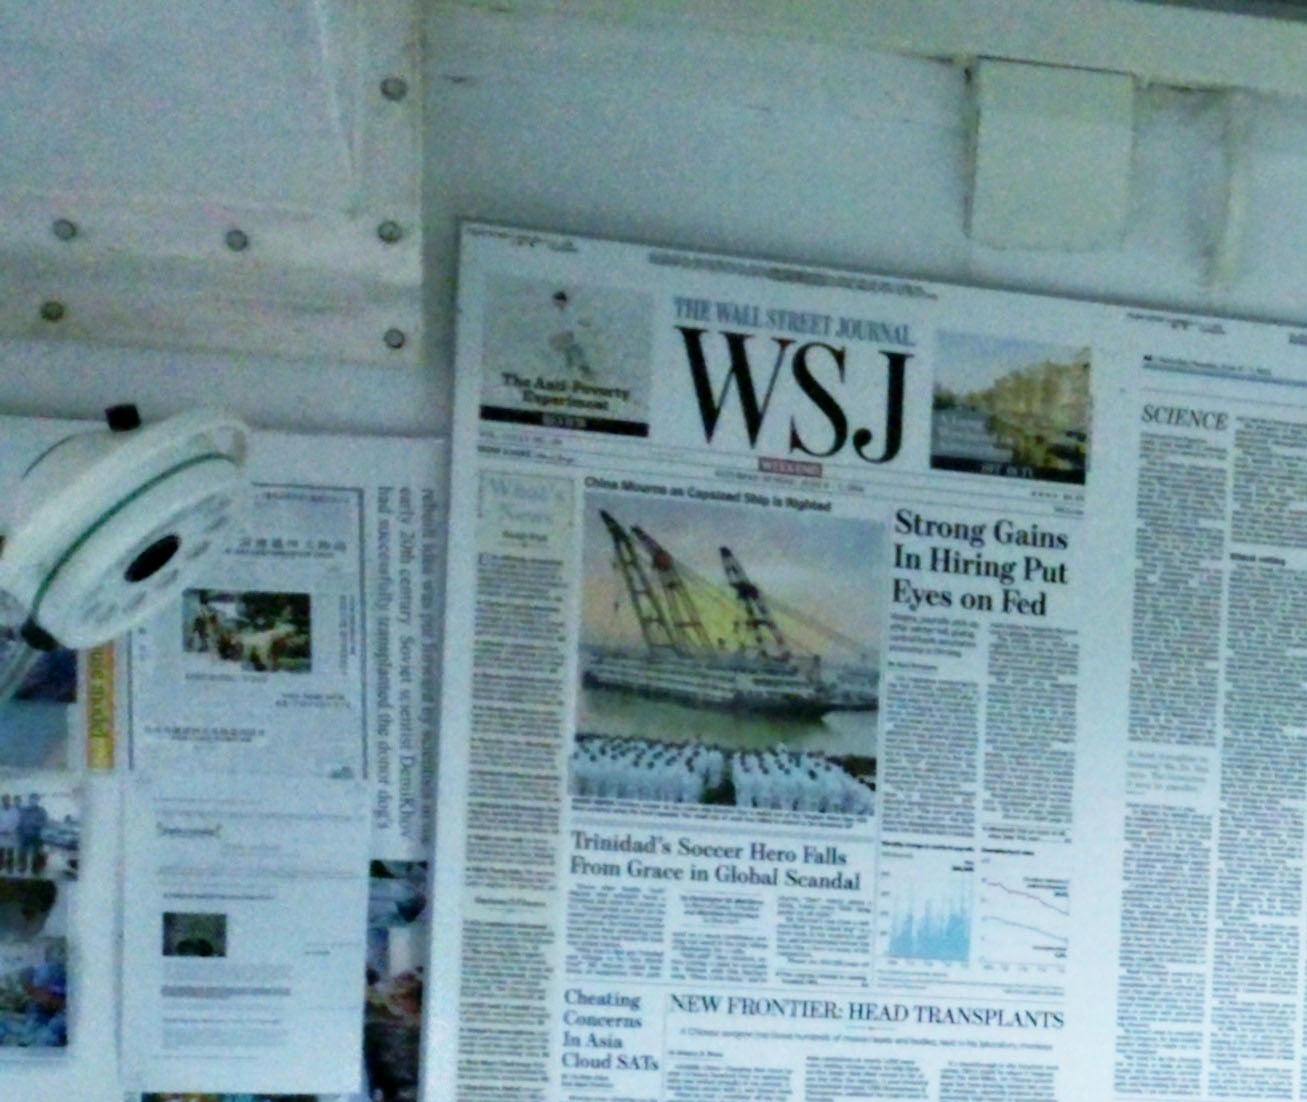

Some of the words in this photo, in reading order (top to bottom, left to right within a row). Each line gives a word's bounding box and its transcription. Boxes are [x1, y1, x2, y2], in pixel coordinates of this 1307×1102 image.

[674, 296, 710, 323] THE
[714, 301, 759, 328] WALL
[766, 308, 832, 336] STREET
[502, 371, 532, 389] The
[675, 326, 914, 464] WSJ
[521, 389, 609, 411] Experiment
[1141, 404, 1229, 431] SCIENCE
[378, 486, 395, 514] had
[583, 475, 620, 491] China
[620, 479, 668, 496] Mourns
[669, 485, 685, 497] as
[687, 484, 741, 504] Capsized
[743, 491, 771, 508] Ship
[785, 496, 833, 513] Righted
[894, 508, 986, 546] Strong
[994, 518, 1068, 550] Gains
[374, 519, 395, 612] successfully
[400, 530, 416, 565] 20th
[892, 543, 921, 569] In
[929, 546, 1017, 584] Hiring
[1024, 556, 1068, 584] Put
[892, 578, 951, 611] Eyes
[960, 589, 993, 611] on
[1002, 588, 1047, 616] Fed
[374, 616, 395, 708] transplanted
[400, 635, 417, 683] Soviet
[378, 713, 394, 737] the
[400, 689, 417, 750] scientist
[378, 740, 394, 785] donor
[570, 831, 672, 854] Trinidad's
[677, 838, 743, 859] Soccer
[750, 843, 797, 863] Hero
[802, 845, 847, 865] Falls
[569, 855, 621, 877] From
[627, 860, 684, 880] Grace
[690, 864, 709, 882] in
[715, 866, 779, 887] Global
[784, 869, 861, 890] Scandal
[564, 989, 641, 1011] Cheating
[670, 993, 720, 1016] NEW
[727, 996, 843, 1020] FRONTIER:
[848, 1000, 909, 1023] HEAD
[915, 1003, 1064, 1030] TRANSPLANTS
[563, 1010, 642, 1030] Concerns
[562, 1031, 581, 1048] In
[585, 1032, 623, 1050] Asia
[561, 1052, 612, 1071] Cloud
[615, 1054, 659, 1072] SATs
